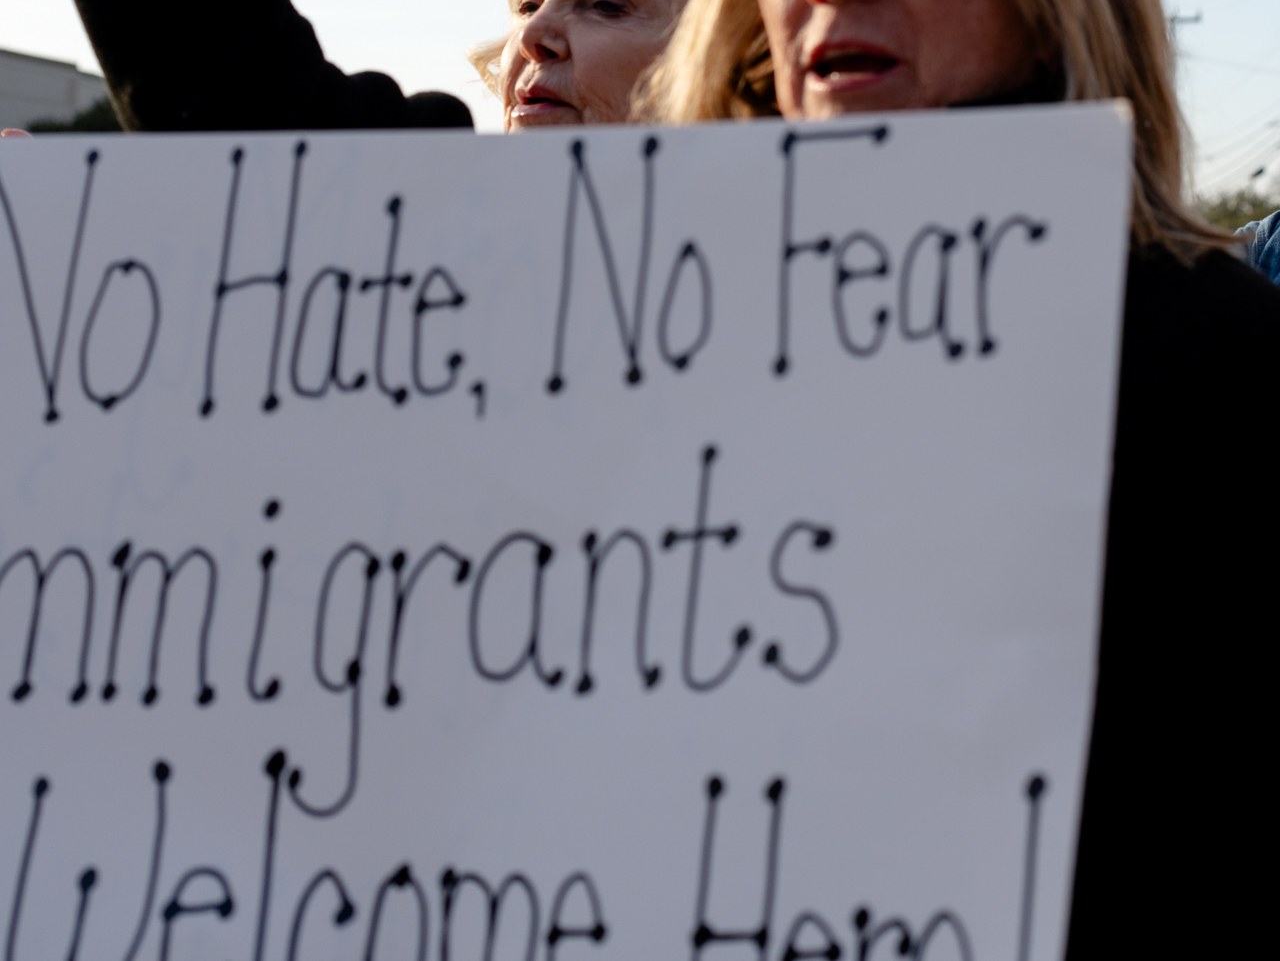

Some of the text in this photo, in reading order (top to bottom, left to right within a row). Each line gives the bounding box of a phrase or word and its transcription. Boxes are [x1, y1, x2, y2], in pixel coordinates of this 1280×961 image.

[198, 137, 490, 421] Hate,
[543, 134, 714, 397] No
[771, 121, 1050, 379] Fear
[0, 442, 842, 819] mmigrants
